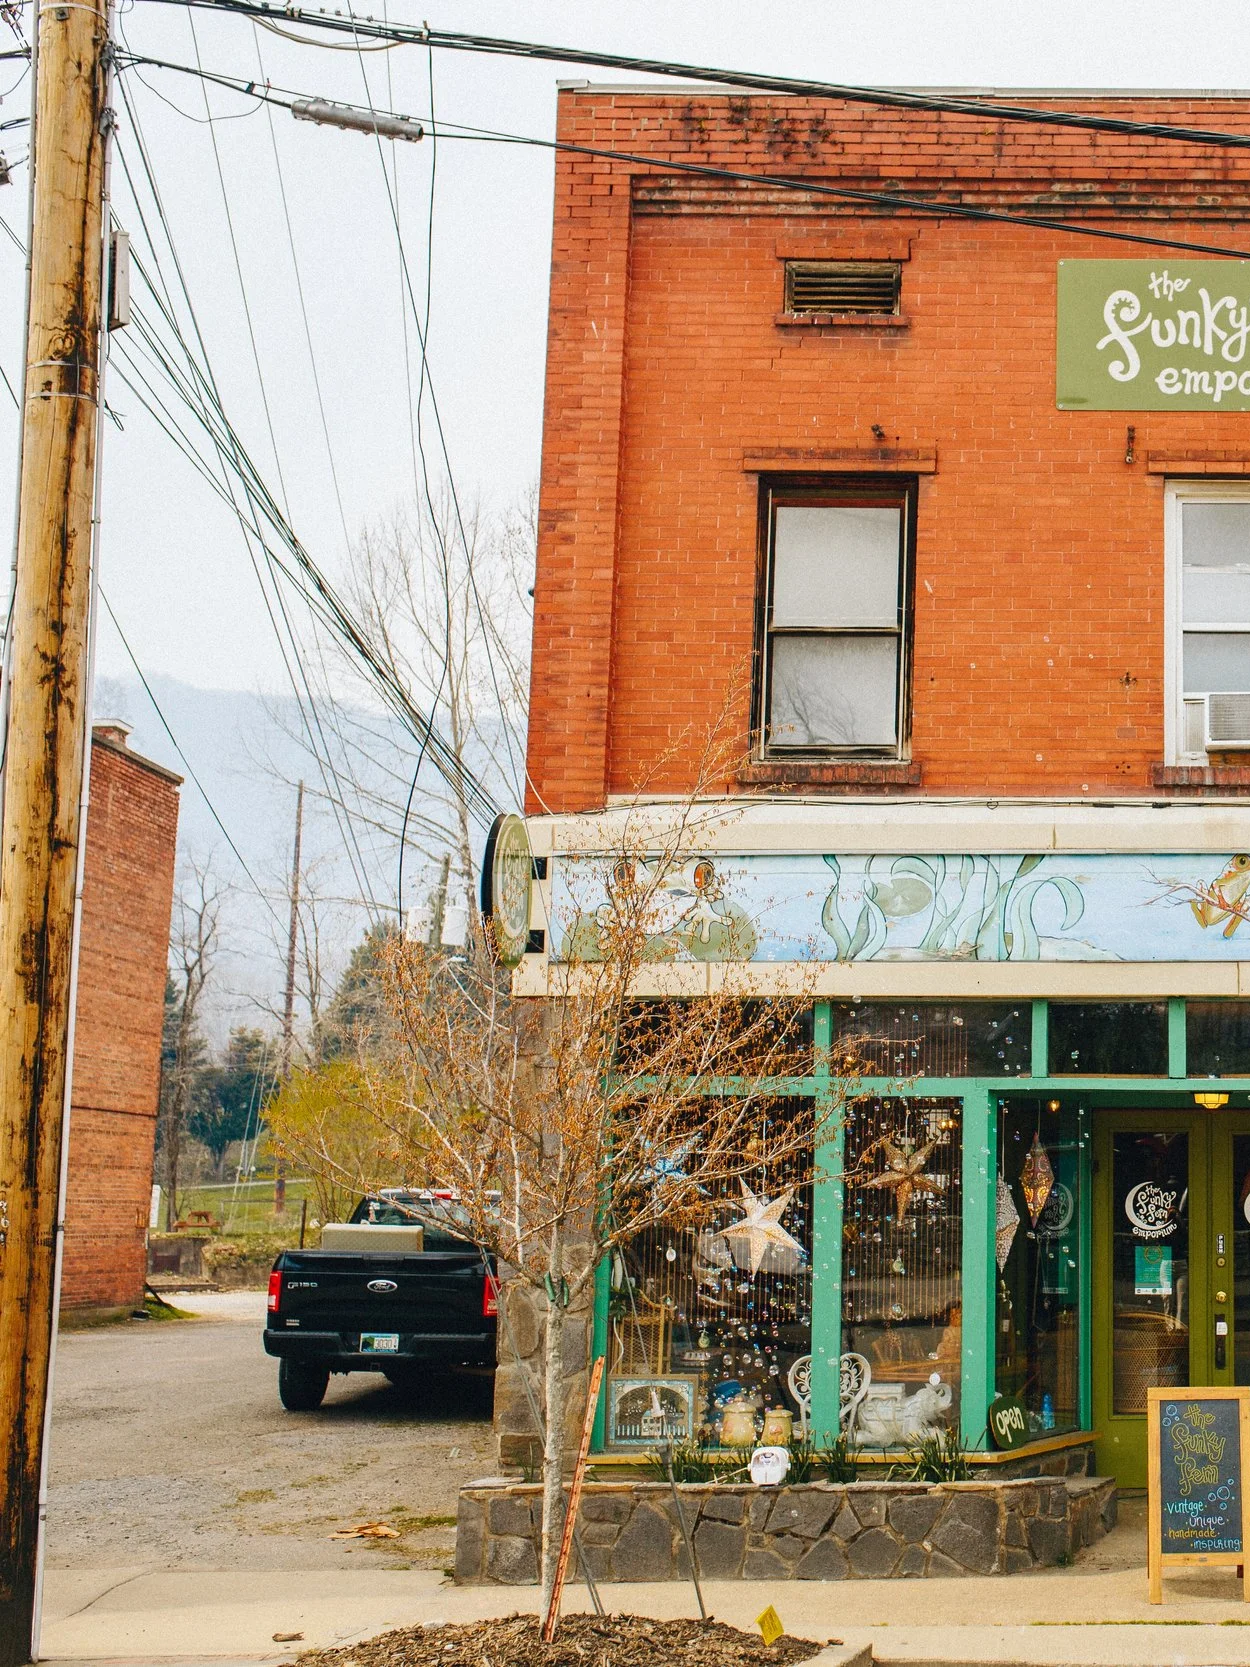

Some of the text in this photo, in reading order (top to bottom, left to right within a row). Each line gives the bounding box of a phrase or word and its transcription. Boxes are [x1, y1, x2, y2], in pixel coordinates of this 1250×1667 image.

[1148, 269, 1191, 301] the
[1183, 1403, 1216, 1430] the
[1168, 1526, 1217, 1540] handmade
